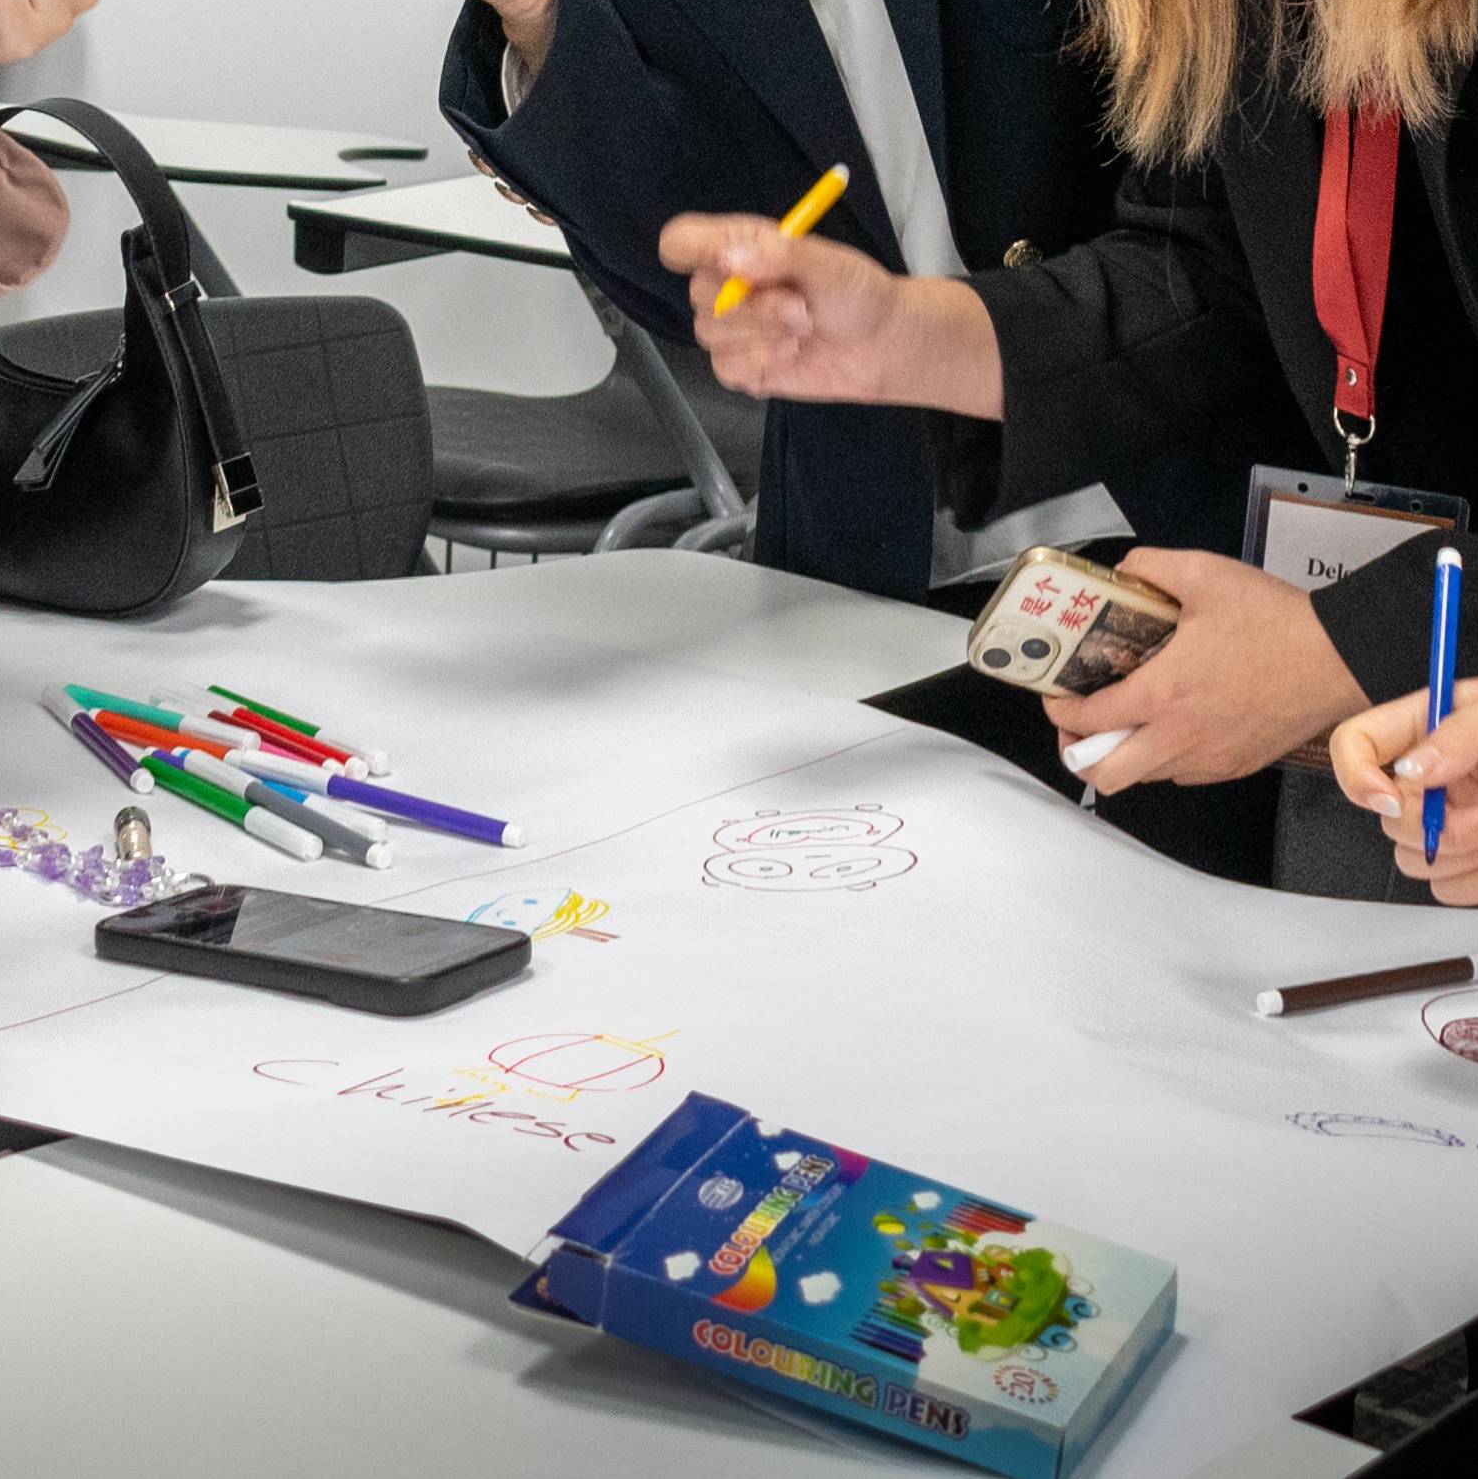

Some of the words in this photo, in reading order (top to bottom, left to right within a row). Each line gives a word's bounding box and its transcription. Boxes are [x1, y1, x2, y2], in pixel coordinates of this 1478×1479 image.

[1020, 575, 1061, 618] 是个
[1057, 589, 1100, 630] 美女
[253, 1059, 616, 1152] Chinese
[709, 1186, 803, 1274] COLOURING
[781, 1154, 834, 1193] PENS
[693, 1319, 878, 1407] COLOURING
[884, 1384, 970, 1439] PENS
